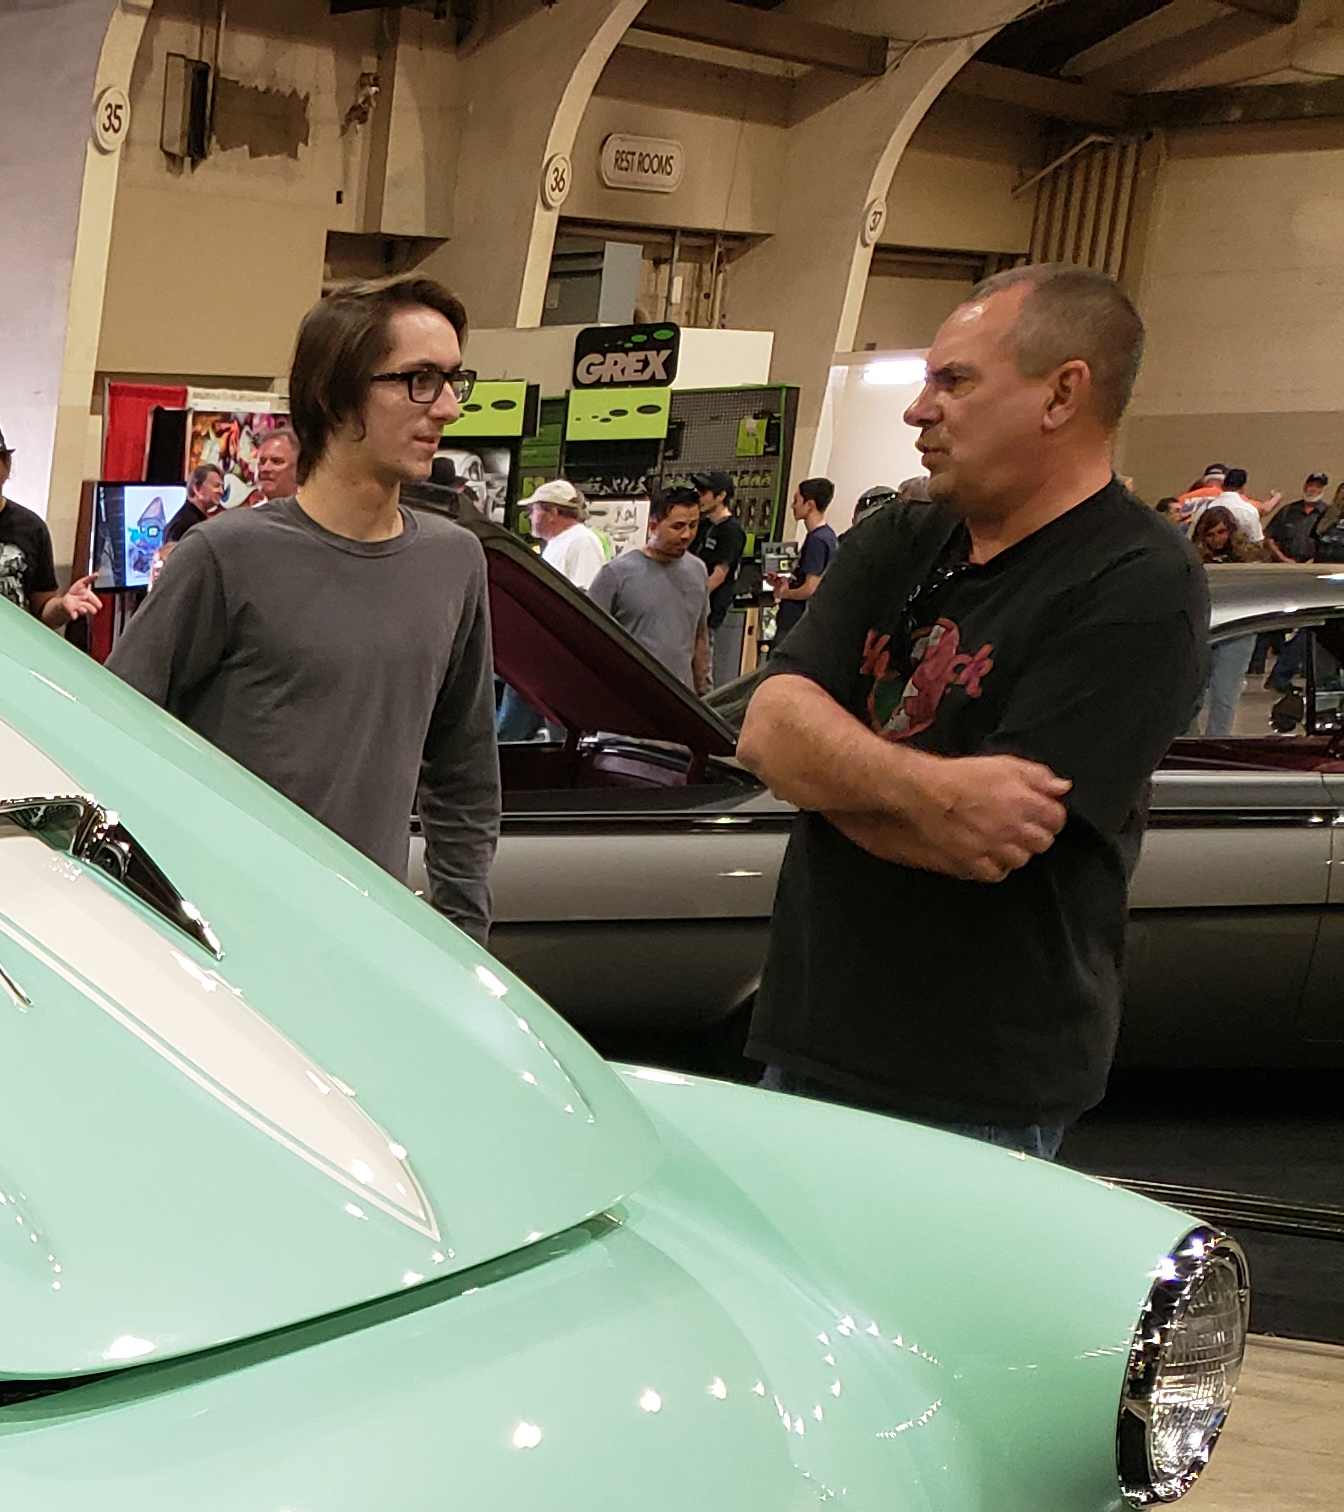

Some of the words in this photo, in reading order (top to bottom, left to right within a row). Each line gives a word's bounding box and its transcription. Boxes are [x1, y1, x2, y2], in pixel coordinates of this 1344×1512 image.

[102, 102, 123, 134] 35
[613, 149, 636, 172] REST
[637, 152, 675, 176] ROOMS
[550, 166, 566, 193] 36
[869, 210, 883, 232] 37
[575, 349, 673, 384] GREX
